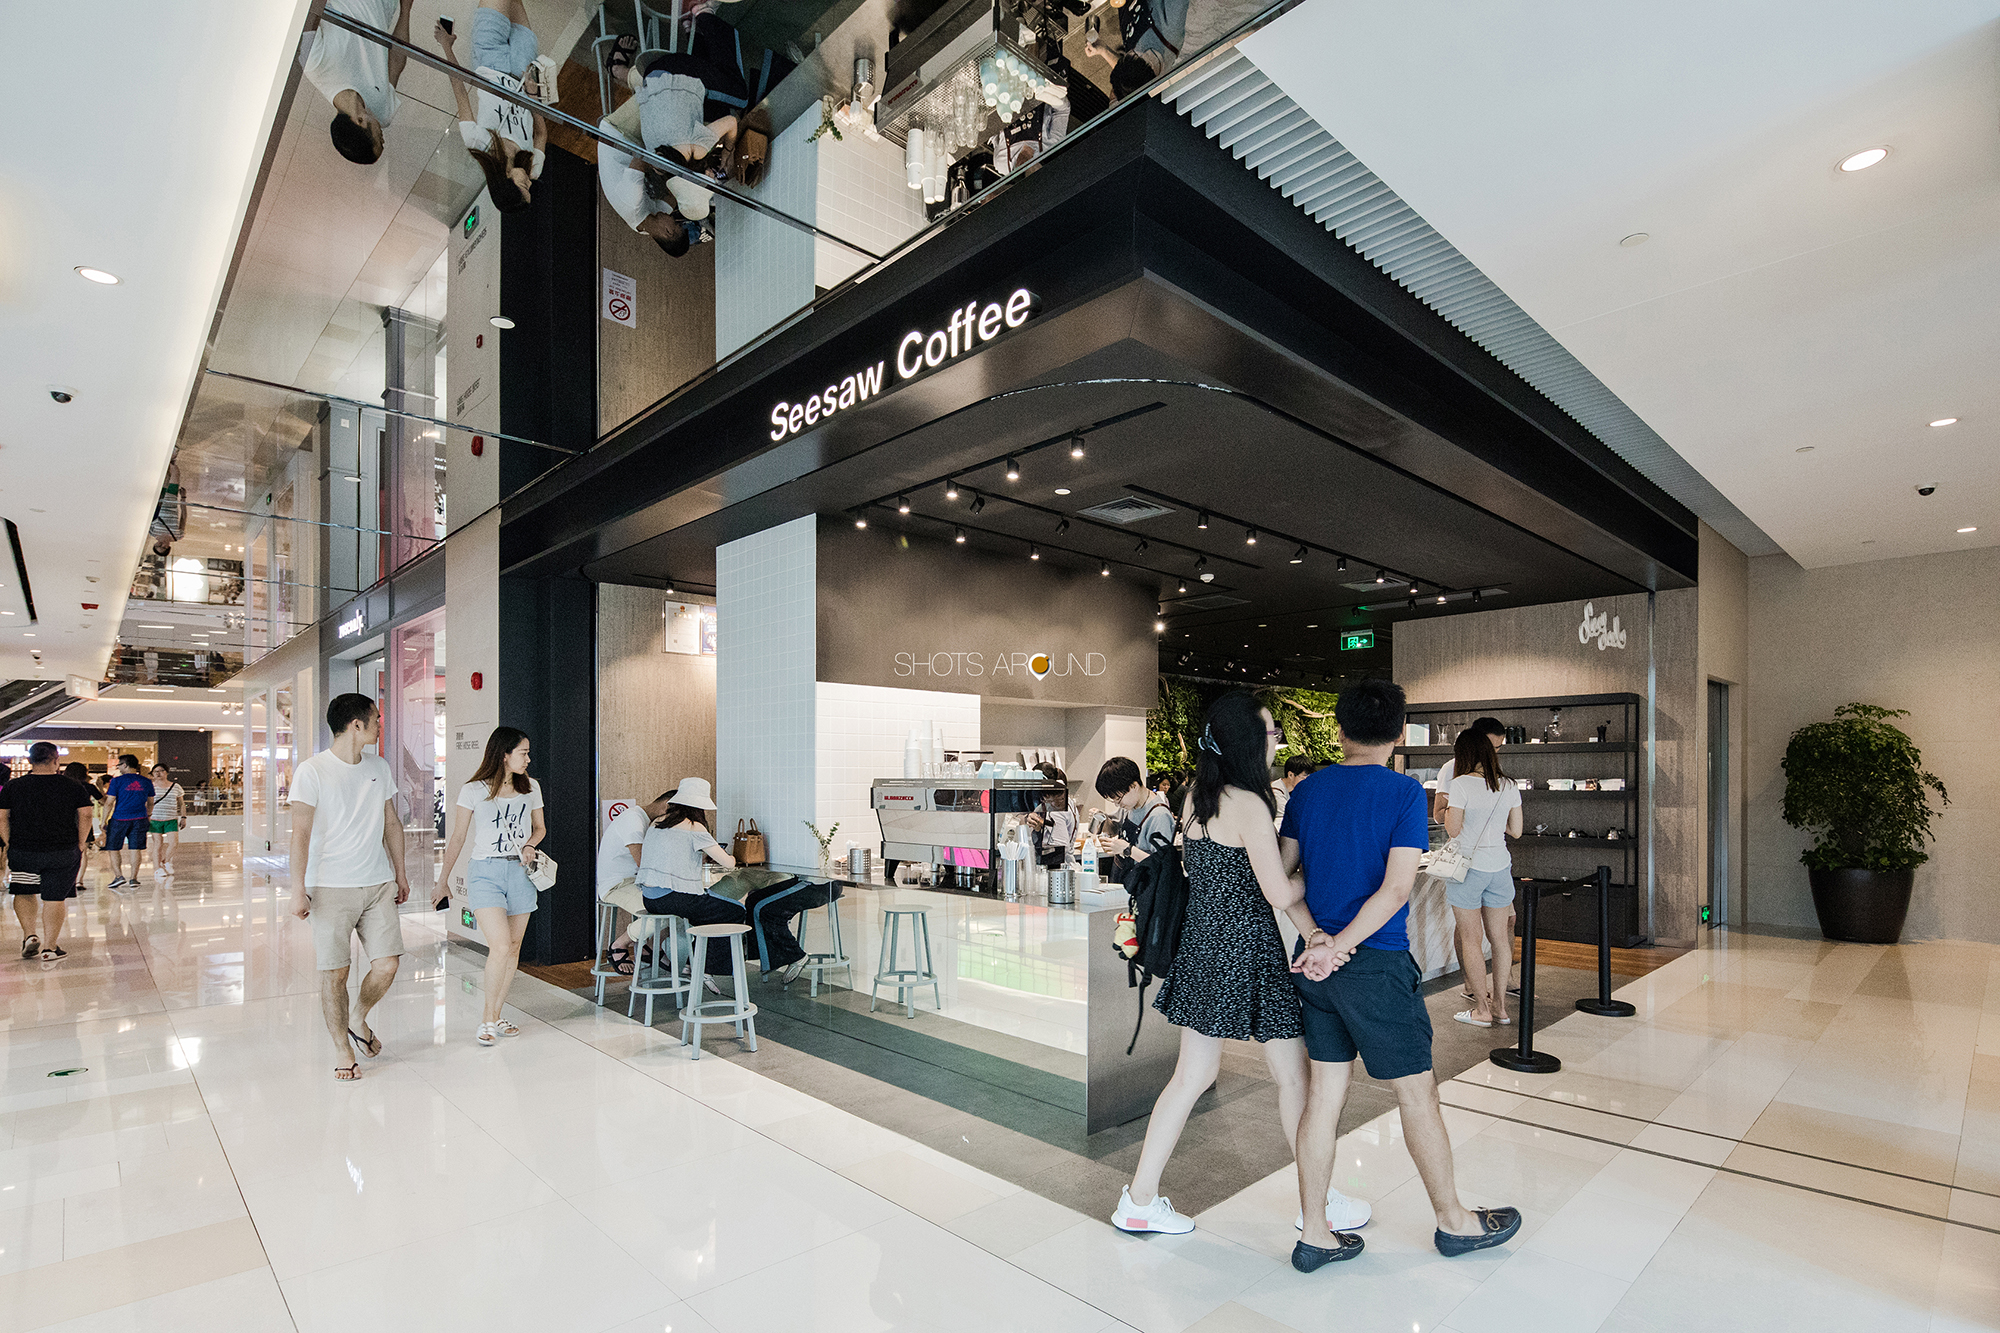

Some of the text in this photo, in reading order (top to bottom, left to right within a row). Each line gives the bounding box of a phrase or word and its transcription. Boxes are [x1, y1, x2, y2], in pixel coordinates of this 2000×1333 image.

[770, 288, 1032, 442] Seesaw Coffee
[893, 651, 984, 677] SHOTS
